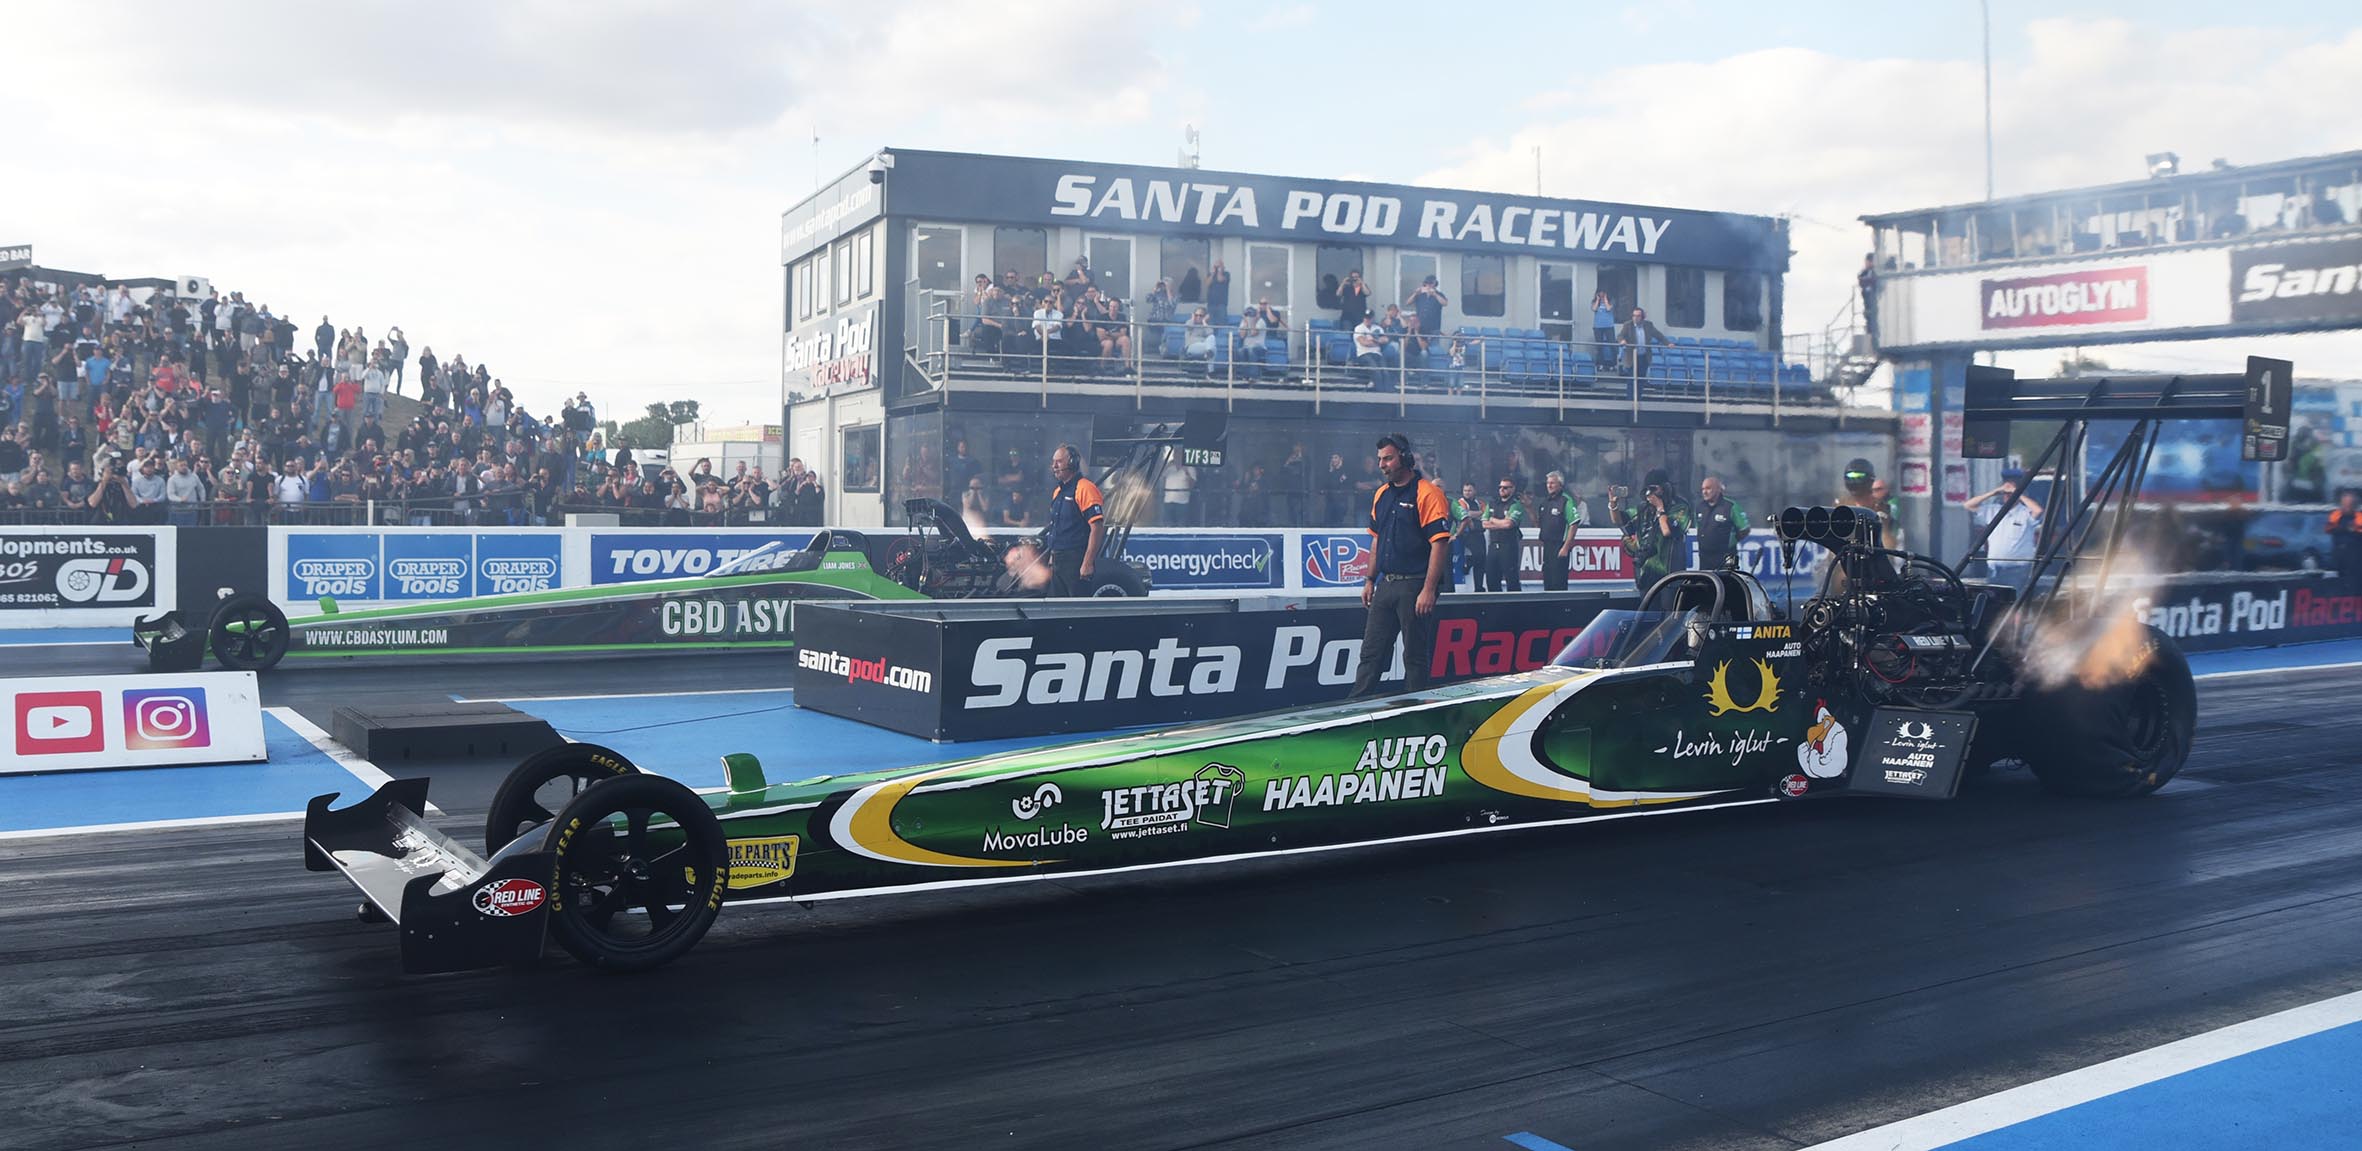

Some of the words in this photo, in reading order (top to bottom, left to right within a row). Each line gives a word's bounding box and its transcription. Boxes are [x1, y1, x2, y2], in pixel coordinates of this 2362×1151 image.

[1050, 174, 1260, 227] SANTA
[1280, 190, 1401, 236] POD
[1417, 199, 1673, 255] RACEWAY
[2238, 263, 2362, 303] San
[1988, 278, 2138, 319] AUTOGLYM
[785, 327, 834, 373] Santa
[836, 308, 874, 358] Pod
[2261, 370, 2273, 414] 1
[1184, 448, 1201, 464] T/F
[1202, 449, 1209, 464] 3
[610, 549, 712, 575] TOYO
[823, 561, 837, 570] LIAM
[838, 561, 856, 570] JONES
[1307, 537, 1359, 582] VP
[1520, 545, 1621, 571] AUGLYM
[301, 563, 367, 576] DRAPER
[396, 562, 460, 576] DRAPER
[489, 562, 549, 575] DRAPER
[1341, 563, 1369, 576] Racin
[304, 575, 367, 595] Tools
[400, 575, 460, 594] Tools
[491, 574, 549, 593] Tools
[17, 593, 59, 602] 821062
[662, 600, 725, 635] CBD
[2229, 589, 2288, 632] Pod
[306, 629, 448, 646] WWW.CBDASYLUM.COM
[1753, 625, 1792, 639] ANITA
[1766, 649, 1801, 658] HAAPANEN
[1783, 642, 1801, 651] AUTO
[798, 648, 932, 694] santapod.com
[964, 636, 1242, 709] Santa
[1356, 734, 1448, 771] AUTO
[1882, 757, 1934, 768] HAAPANEN
[1907, 752, 1935, 761] AUTO
[591, 754, 627, 775] EAGLE
[1262, 765, 1448, 812] HAAPANEN
[1100, 779, 1232, 830] JETTASET
[1120, 818, 1140, 826] TEE
[1142, 813, 1178, 824] PAIDAT
[983, 823, 1088, 852] MovaLube
[1111, 823, 1188, 840] www.jettaset.fi
[745, 842, 790, 870] PARTS
[494, 890, 516, 904] RED
[517, 888, 542, 902] LINE
[707, 867, 726, 911] EAGLE
